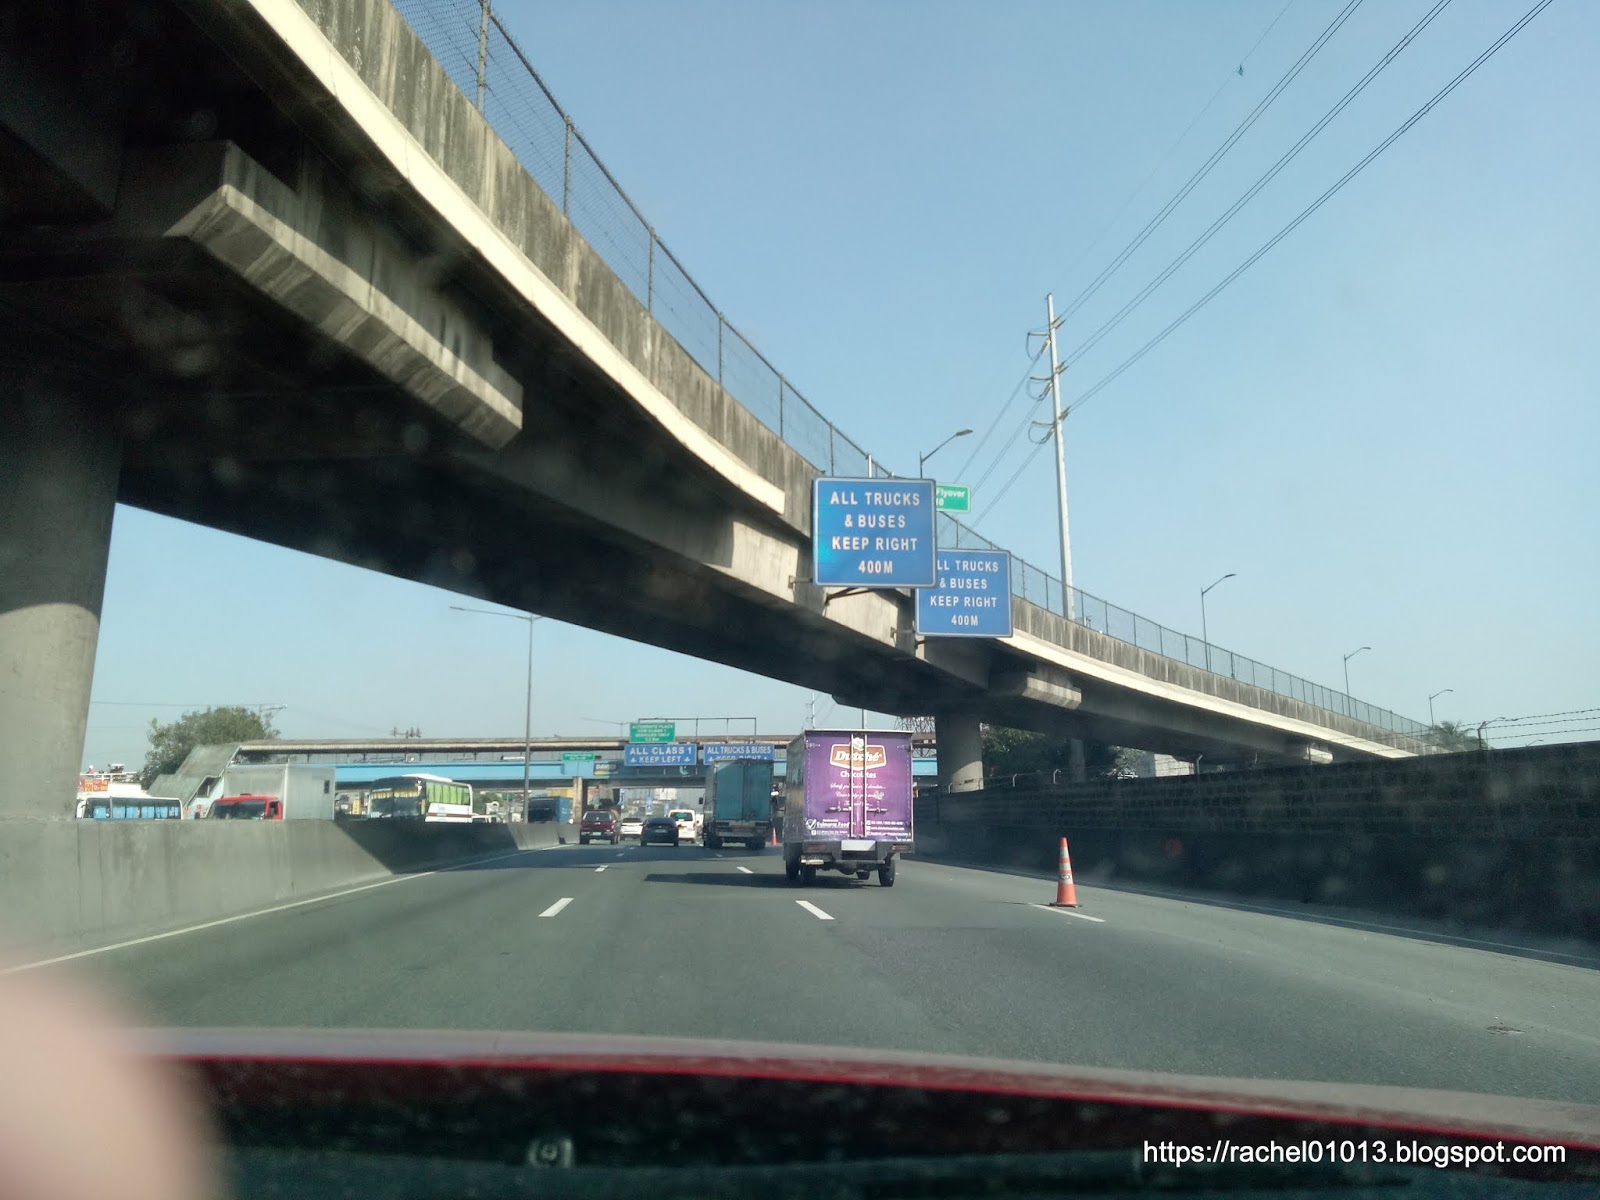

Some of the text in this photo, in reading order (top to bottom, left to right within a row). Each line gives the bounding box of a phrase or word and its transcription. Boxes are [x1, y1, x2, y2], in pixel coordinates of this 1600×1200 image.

[830, 491, 920, 506] ALL TRUCKS
[844, 514, 906, 528] & BUSES
[832, 536, 918, 551] KEEP RIGHT
[858, 560, 893, 574] 400M
[936, 559, 999, 572] LL TRUCKS
[939, 577, 988, 590] & BUSES
[930, 595, 997, 608] KEEP RIGHT
[951, 614, 979, 626] 400M
[629, 746, 692, 755] ALL CLASS 1
[706, 746, 771, 754] ALL TRUCKS & BUSES
[639, 755, 682, 763] KEEP LEFT
[840, 770, 877, 779] Chcoltes
